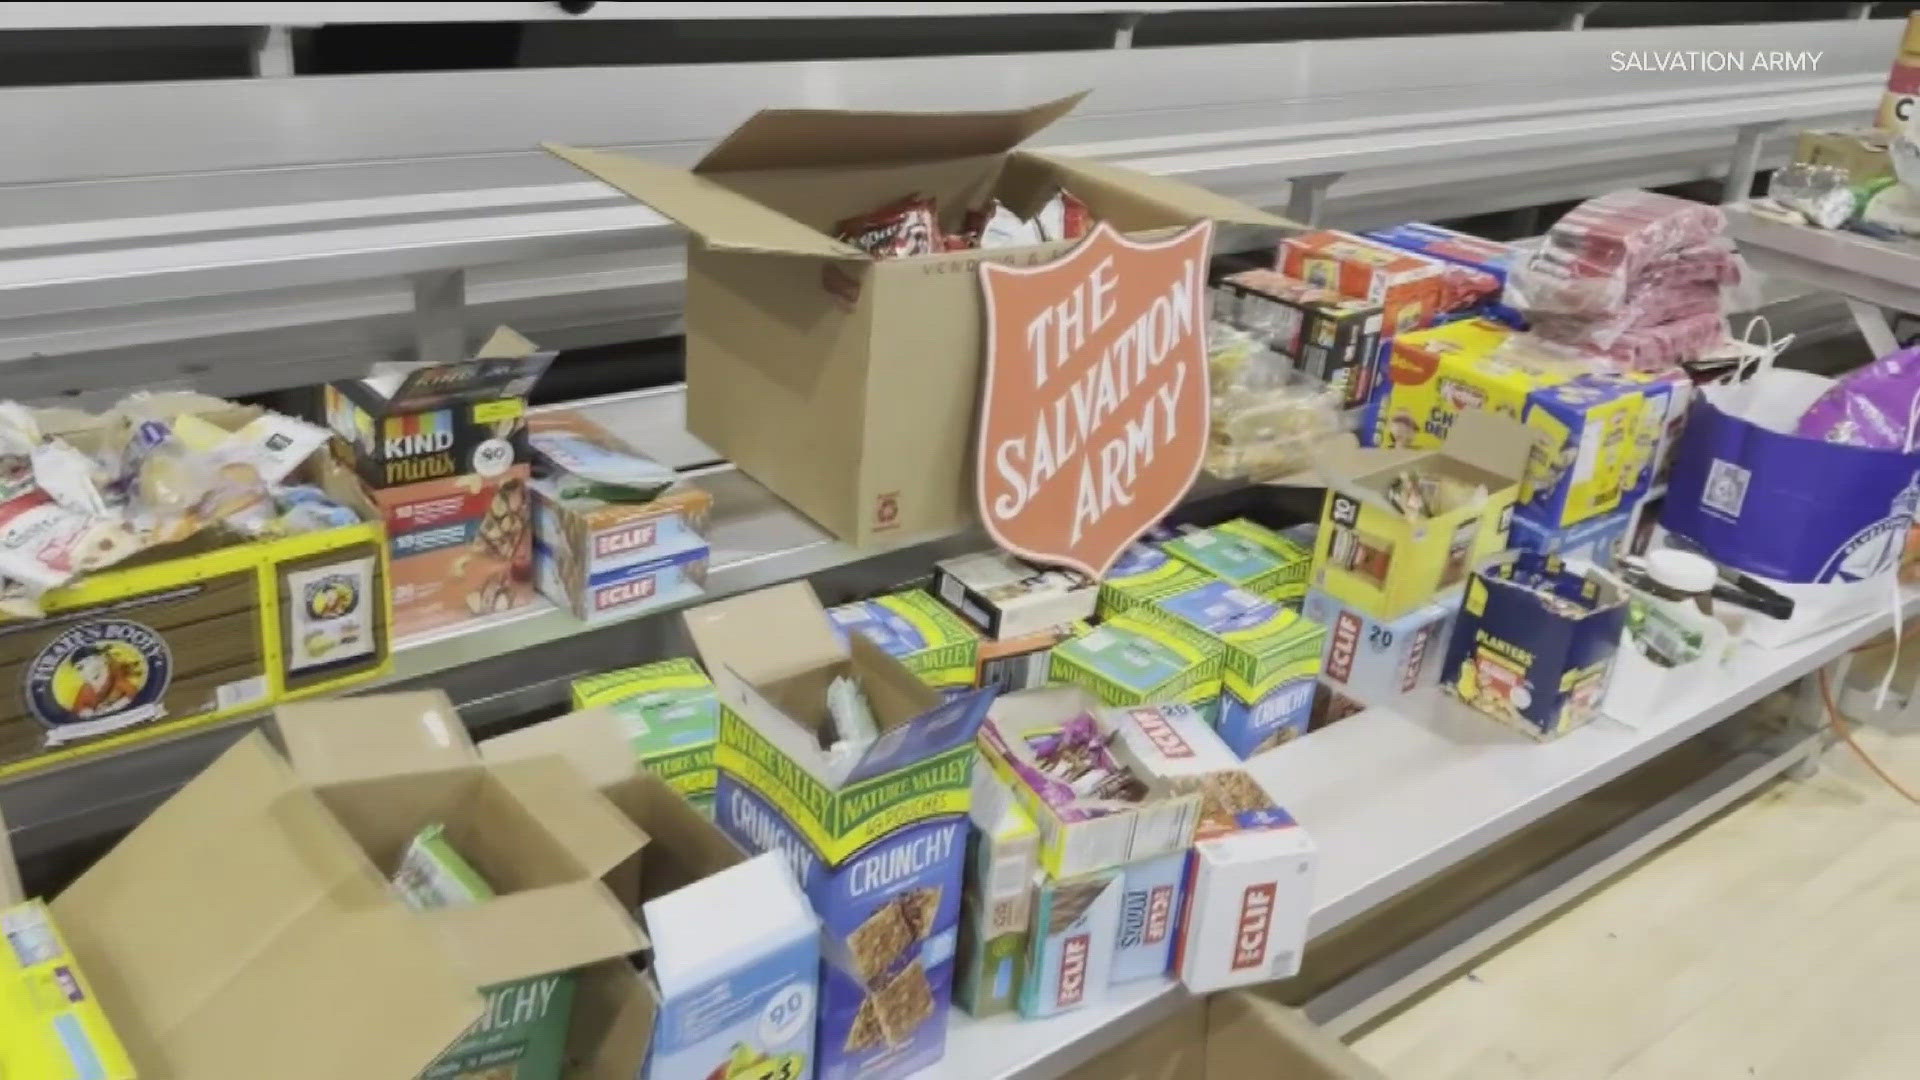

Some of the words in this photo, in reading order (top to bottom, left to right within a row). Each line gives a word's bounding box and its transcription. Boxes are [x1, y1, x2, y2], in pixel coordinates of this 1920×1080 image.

[1027, 255, 1119, 389] THE
[994, 259, 1194, 519] SALVATION
[385, 431, 454, 459] KIND
[386, 455, 456, 484] minis
[1070, 361, 1187, 548] ARMY
[1368, 624, 1393, 647] 20
[842, 777, 914, 824] NATURE
[913, 754, 970, 789] VALLEY
[848, 823, 957, 897] CRUNCHY
[769, 991, 801, 1024] 90
